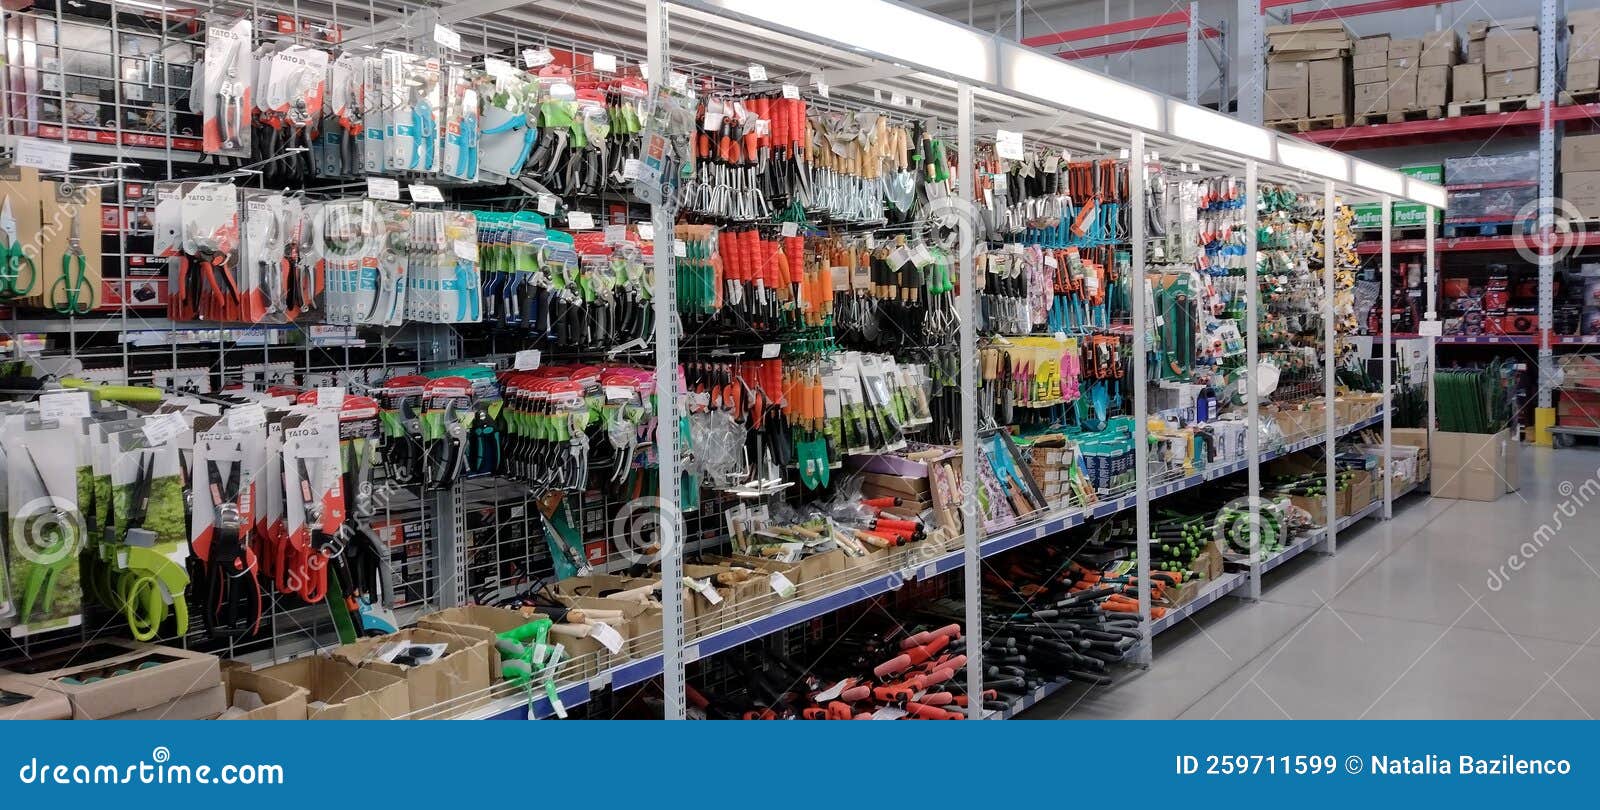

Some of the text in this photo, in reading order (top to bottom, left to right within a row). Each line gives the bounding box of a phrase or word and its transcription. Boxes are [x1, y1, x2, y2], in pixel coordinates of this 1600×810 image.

[211, 28, 230, 38] YATO
[280, 53, 298, 63] YATO
[249, 202, 266, 210] YATO
[199, 433, 221, 441] YATO
[289, 429, 309, 438] YATO
